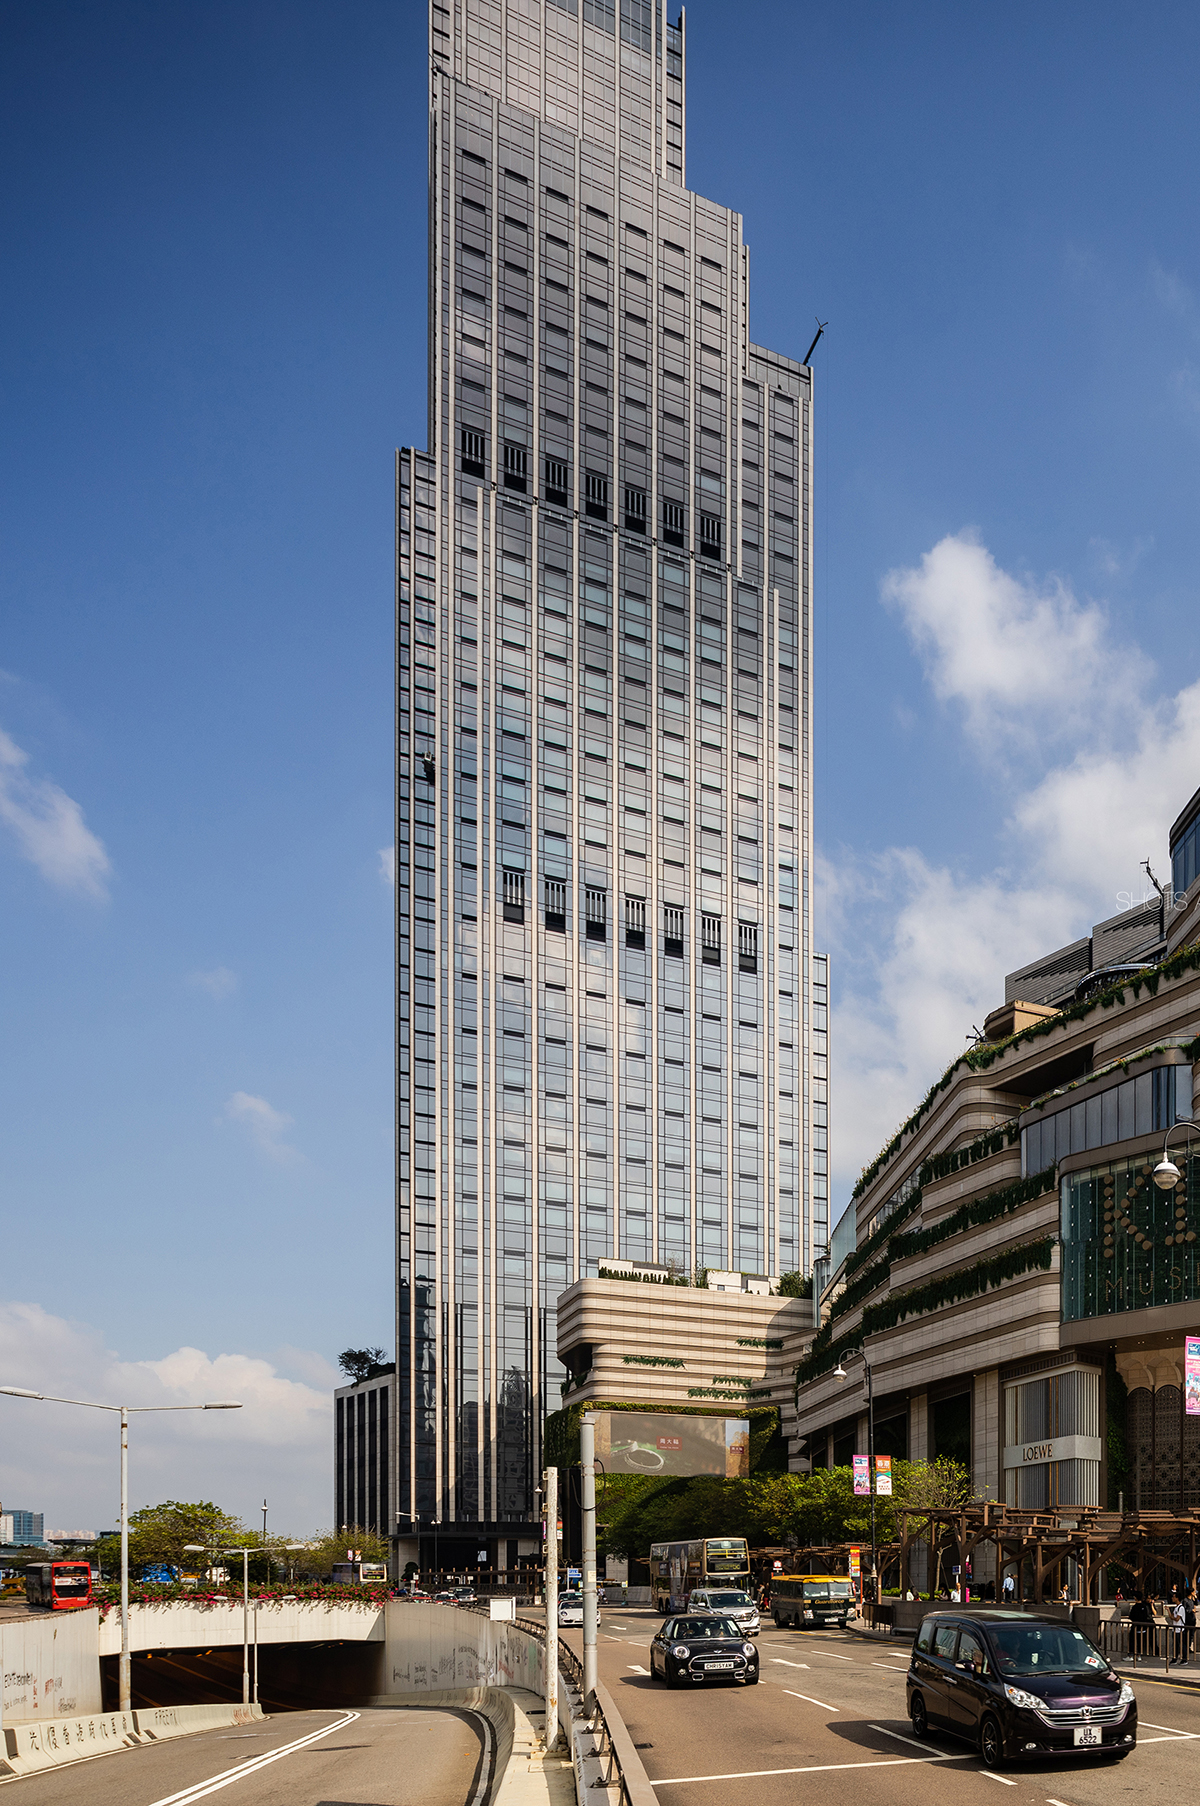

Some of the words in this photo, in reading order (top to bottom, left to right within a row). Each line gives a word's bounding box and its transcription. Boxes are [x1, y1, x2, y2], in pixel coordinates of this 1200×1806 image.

[1022, 1443, 1053, 1461] LOEWE
[1083, 1728, 1093, 1736] UX
[1079, 1735, 1097, 1744] 6522
